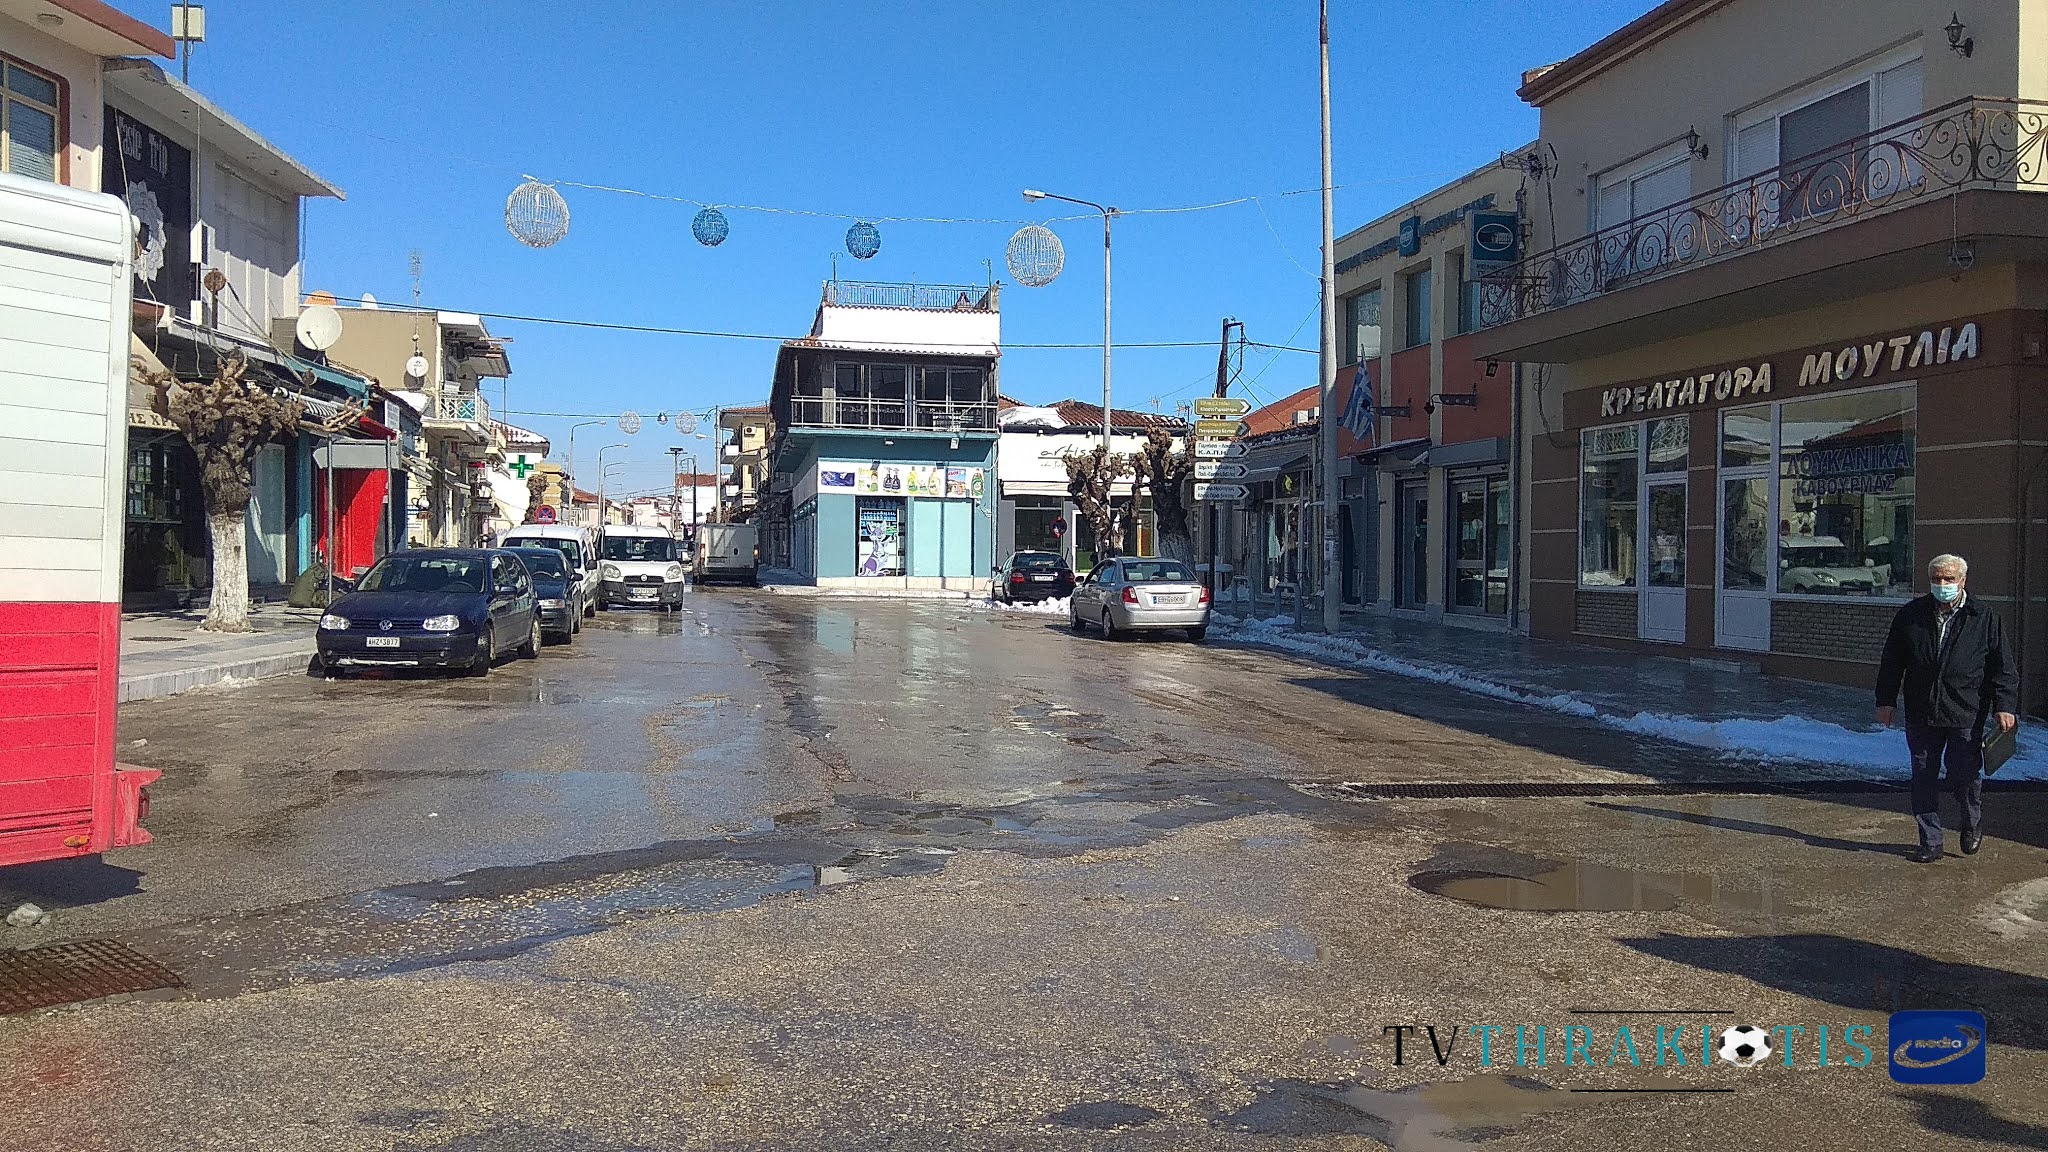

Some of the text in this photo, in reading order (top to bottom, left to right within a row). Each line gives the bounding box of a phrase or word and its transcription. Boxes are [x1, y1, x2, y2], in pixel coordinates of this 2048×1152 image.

[1601, 322, 1977, 417] ΚΡΕΑΤΑΓΟΡΑ ΜΟΥΤΛΙΑ
[1786, 442, 1910, 476] ΛΟΥΚΑΝΙΚΑ
[1796, 473, 1896, 497] ΚΑΒΟΥΡΜΑΣ
